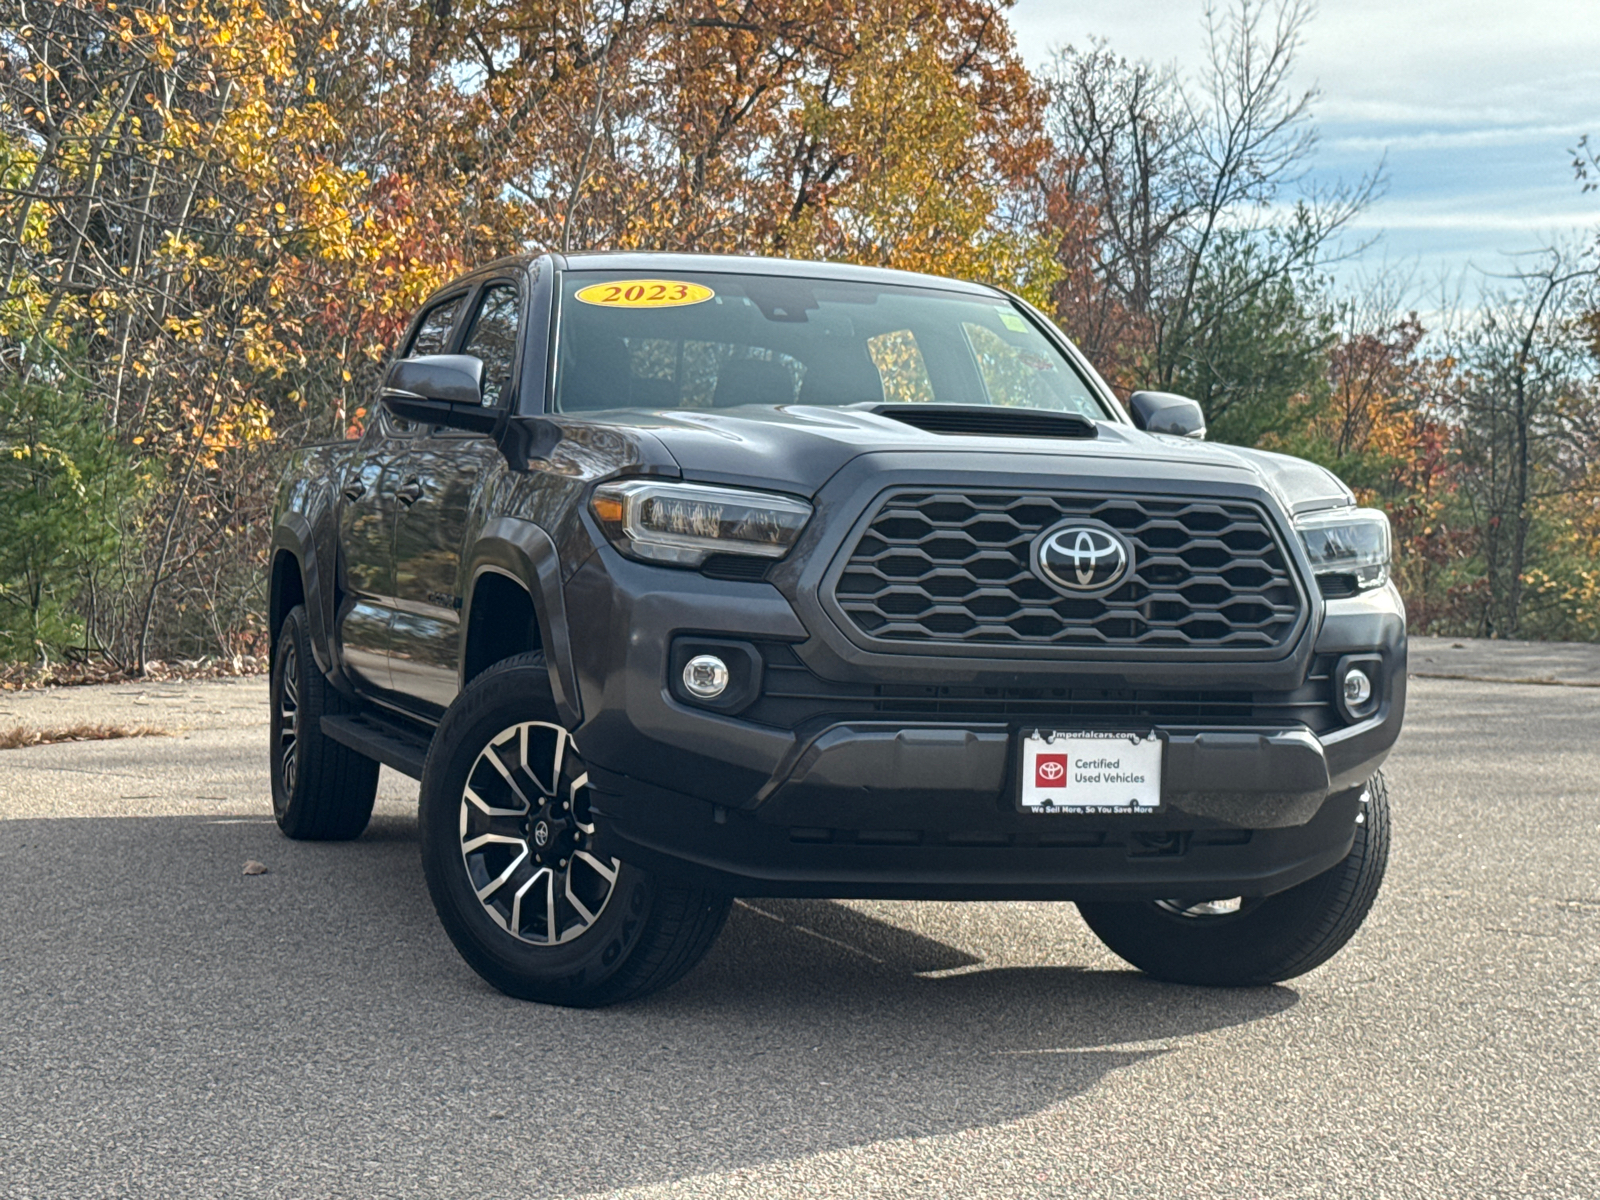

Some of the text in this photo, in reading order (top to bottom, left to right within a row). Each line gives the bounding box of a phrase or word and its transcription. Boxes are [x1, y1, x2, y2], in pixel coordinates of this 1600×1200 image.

[601, 284, 689, 302] 2023
[1052, 730, 1136, 740] Imperialcars.com
[1075, 758, 1120, 769] Certified
[1075, 772, 1145, 783] Used Vehicles
[1062, 806, 1084, 815] More,
